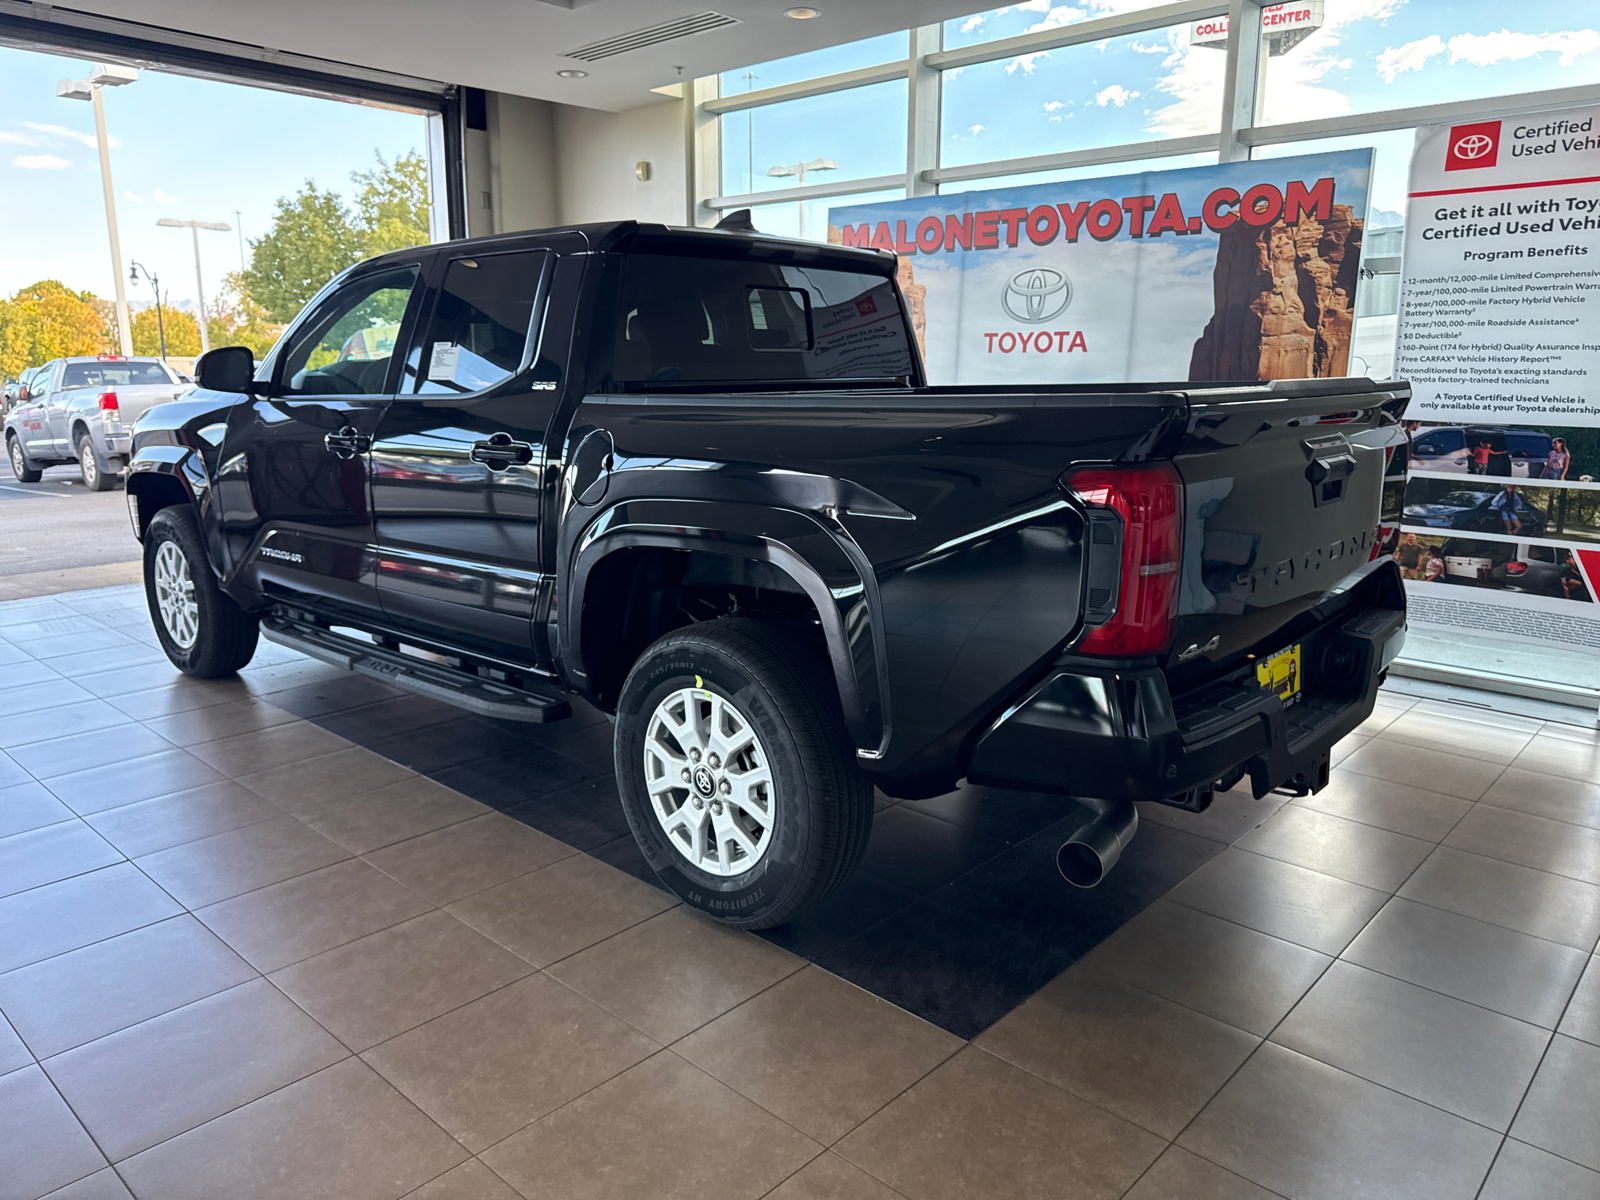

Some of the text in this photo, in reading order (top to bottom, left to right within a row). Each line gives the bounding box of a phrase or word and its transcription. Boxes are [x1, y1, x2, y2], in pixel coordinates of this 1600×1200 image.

[1196, 9, 1311, 36] COLLI CENTER
[1513, 117, 1593, 140] Certified
[1511, 139, 1557, 157] Used
[1434, 197, 1600, 221] Get it all with Toy
[842, 177, 1336, 256] MALONETOYOTA.COM
[1422, 221, 1501, 241] Certified
[1506, 218, 1554, 235] Used
[1463, 244, 1589, 262] Program Benefits
[1408, 274, 1498, 285] 12-month/12,000-mile
[1500, 272, 1533, 280] Limited
[1407, 286, 1489, 297] 7-year/100,000-mile
[1491, 285, 1524, 293] Limited
[1525, 283, 1573, 292] Powertrain
[1406, 295, 1586, 309] 8-year/100,000-mile Factory Hybrid Vehicle
[1404, 320, 1486, 329] 7-year/100,000-mile
[984, 331, 1088, 354] TOYOTA
[1440, 344, 1457, 352] (174
[1458, 343, 1470, 351] for
[1471, 343, 1502, 352] Hybrid)
[1503, 343, 1534, 352] Quality
[1536, 343, 1580, 351] Assurance
[1488, 355, 1519, 364] History
[1470, 367, 1502, 375] Toyota's
[1503, 368, 1541, 376] exacting
[1542, 368, 1587, 376] standards
[531, 381, 557, 390] SR5
[1410, 376, 1437, 384] Toyota
[1438, 376, 1499, 384] factory-trained
[1501, 377, 1550, 385] technicians
[1443, 393, 1472, 402] Toyota
[1474, 393, 1514, 402] Certified
[1541, 395, 1576, 403] Vehicle
[1577, 396, 1586, 404] is
[1420, 402, 1440, 410] only
[1440, 402, 1481, 410] available
[1482, 403, 1492, 411] at
[1493, 404, 1515, 412] your
[1516, 404, 1547, 413] Toyota
[649, 662, 695, 679] 245/70R17
[687, 887, 765, 911] TERRITORY HT
